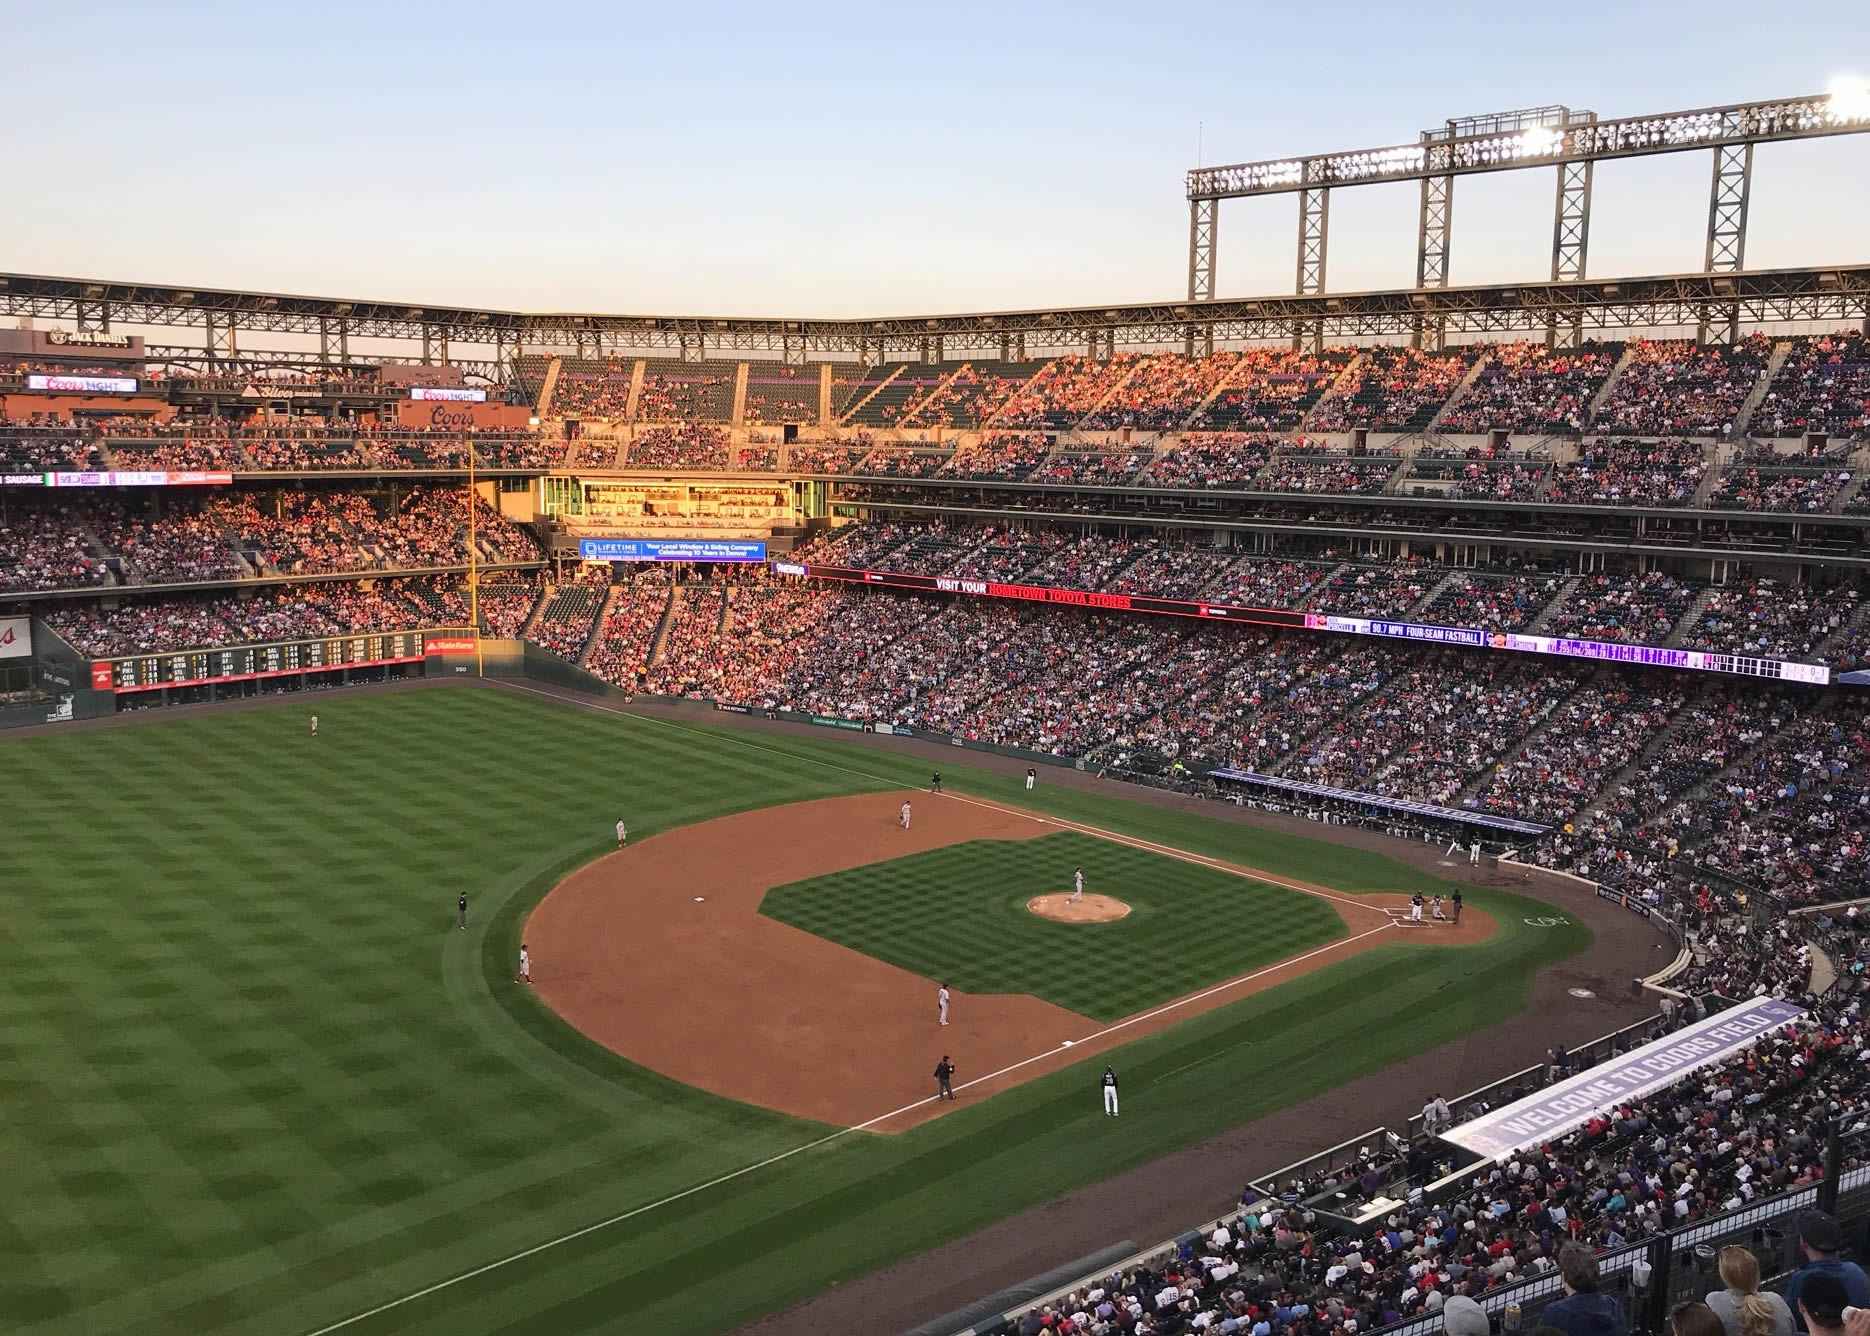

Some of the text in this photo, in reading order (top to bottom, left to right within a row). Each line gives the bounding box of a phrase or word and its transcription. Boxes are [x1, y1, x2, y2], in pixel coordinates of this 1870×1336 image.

[69, 331, 92, 342] JACK
[46, 376, 84, 390] Coors
[430, 404, 474, 425] Coors
[4, 475, 44, 484] SAUSAGE
[936, 579, 1131, 608] VISIT YOUR HOMETOWN TOYOTA STORES
[1372, 623, 1387, 633] 90.7
[1388, 625, 1403, 635] MPH
[1406, 627, 1444, 640] FOUR-SEAM
[1445, 630, 1478, 643] FASTBALL
[1500, 1014, 1772, 1135] WELCOME TO COORS FIELD
